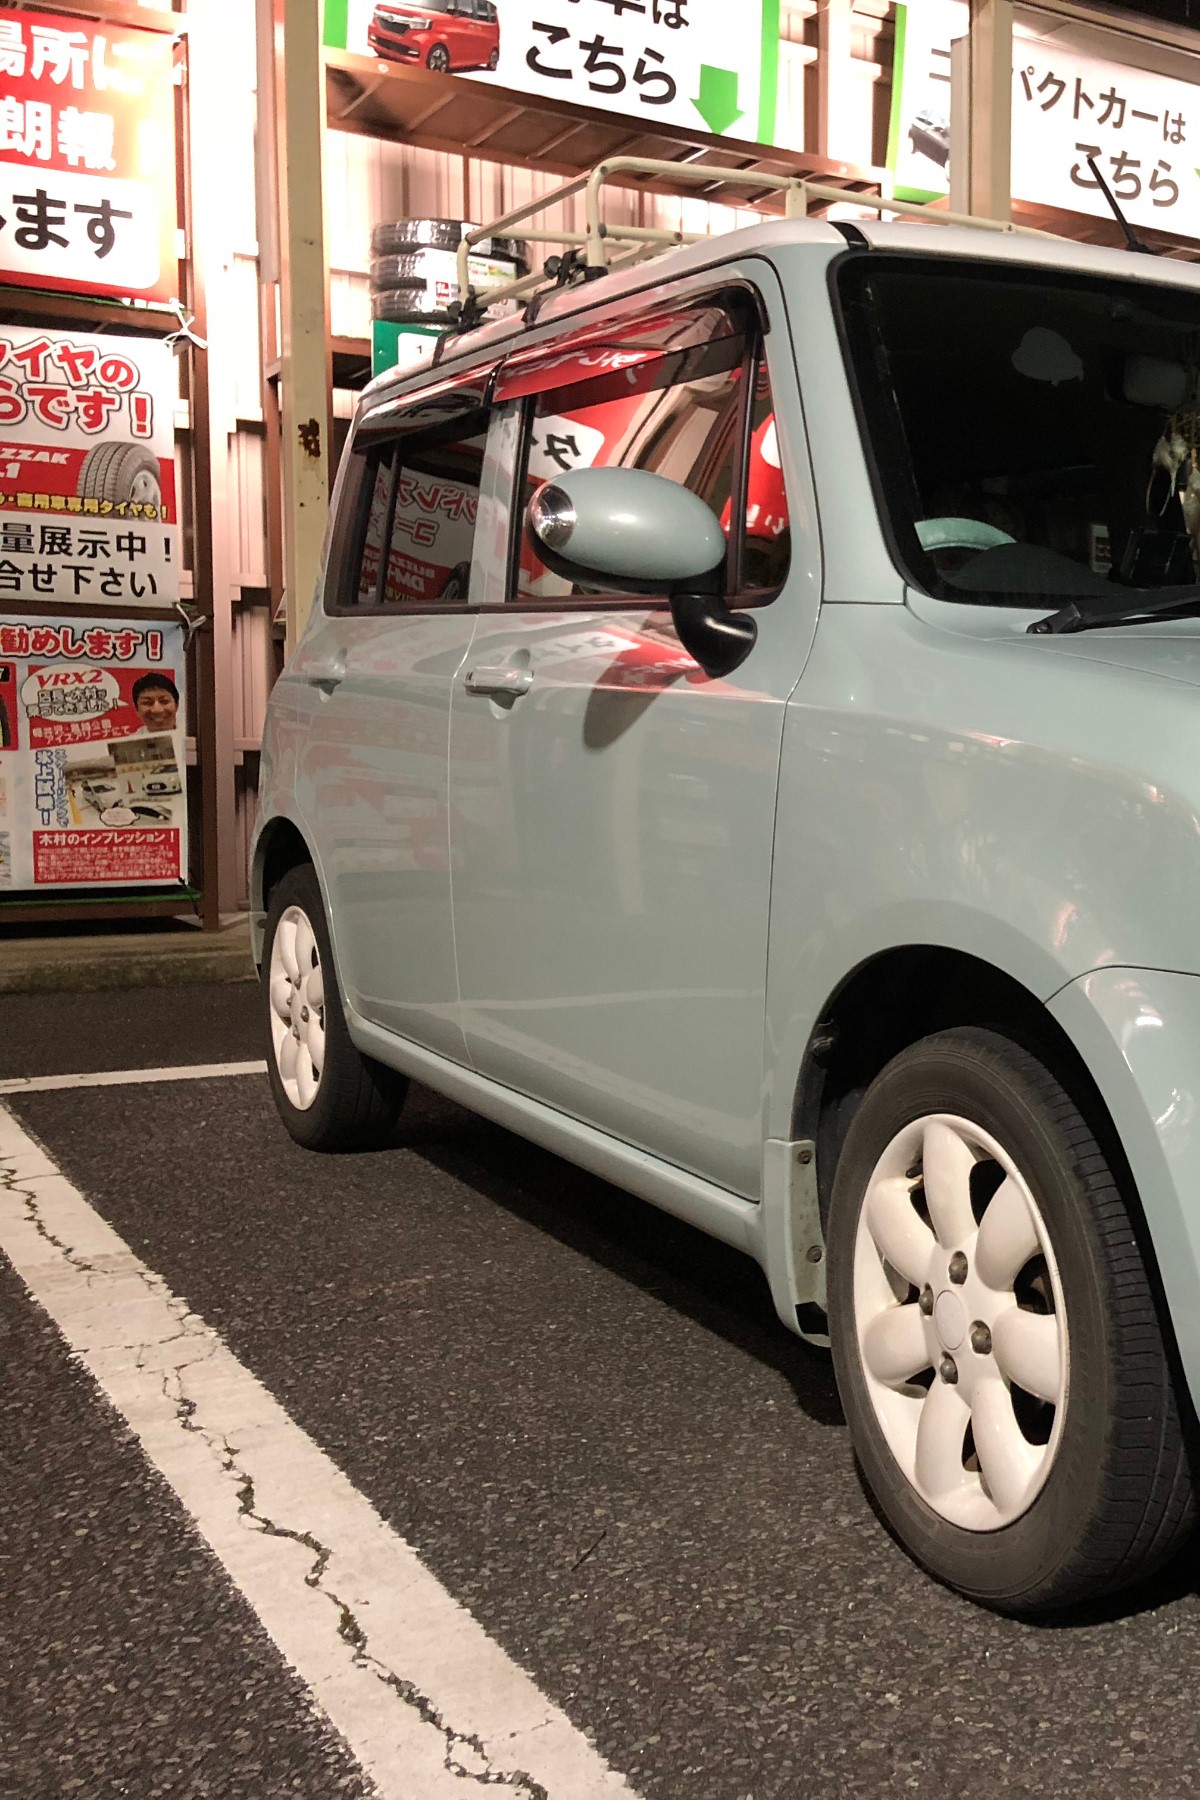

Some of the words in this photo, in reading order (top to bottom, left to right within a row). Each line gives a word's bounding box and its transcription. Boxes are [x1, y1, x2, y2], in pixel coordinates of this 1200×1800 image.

[525, 21, 677, 105] こちら
[1069, 142, 1180, 208] こちら
[0, 189, 133, 259] ます
[0, 341, 134, 388] イヤの
[36, 669, 104, 690] VRX2
